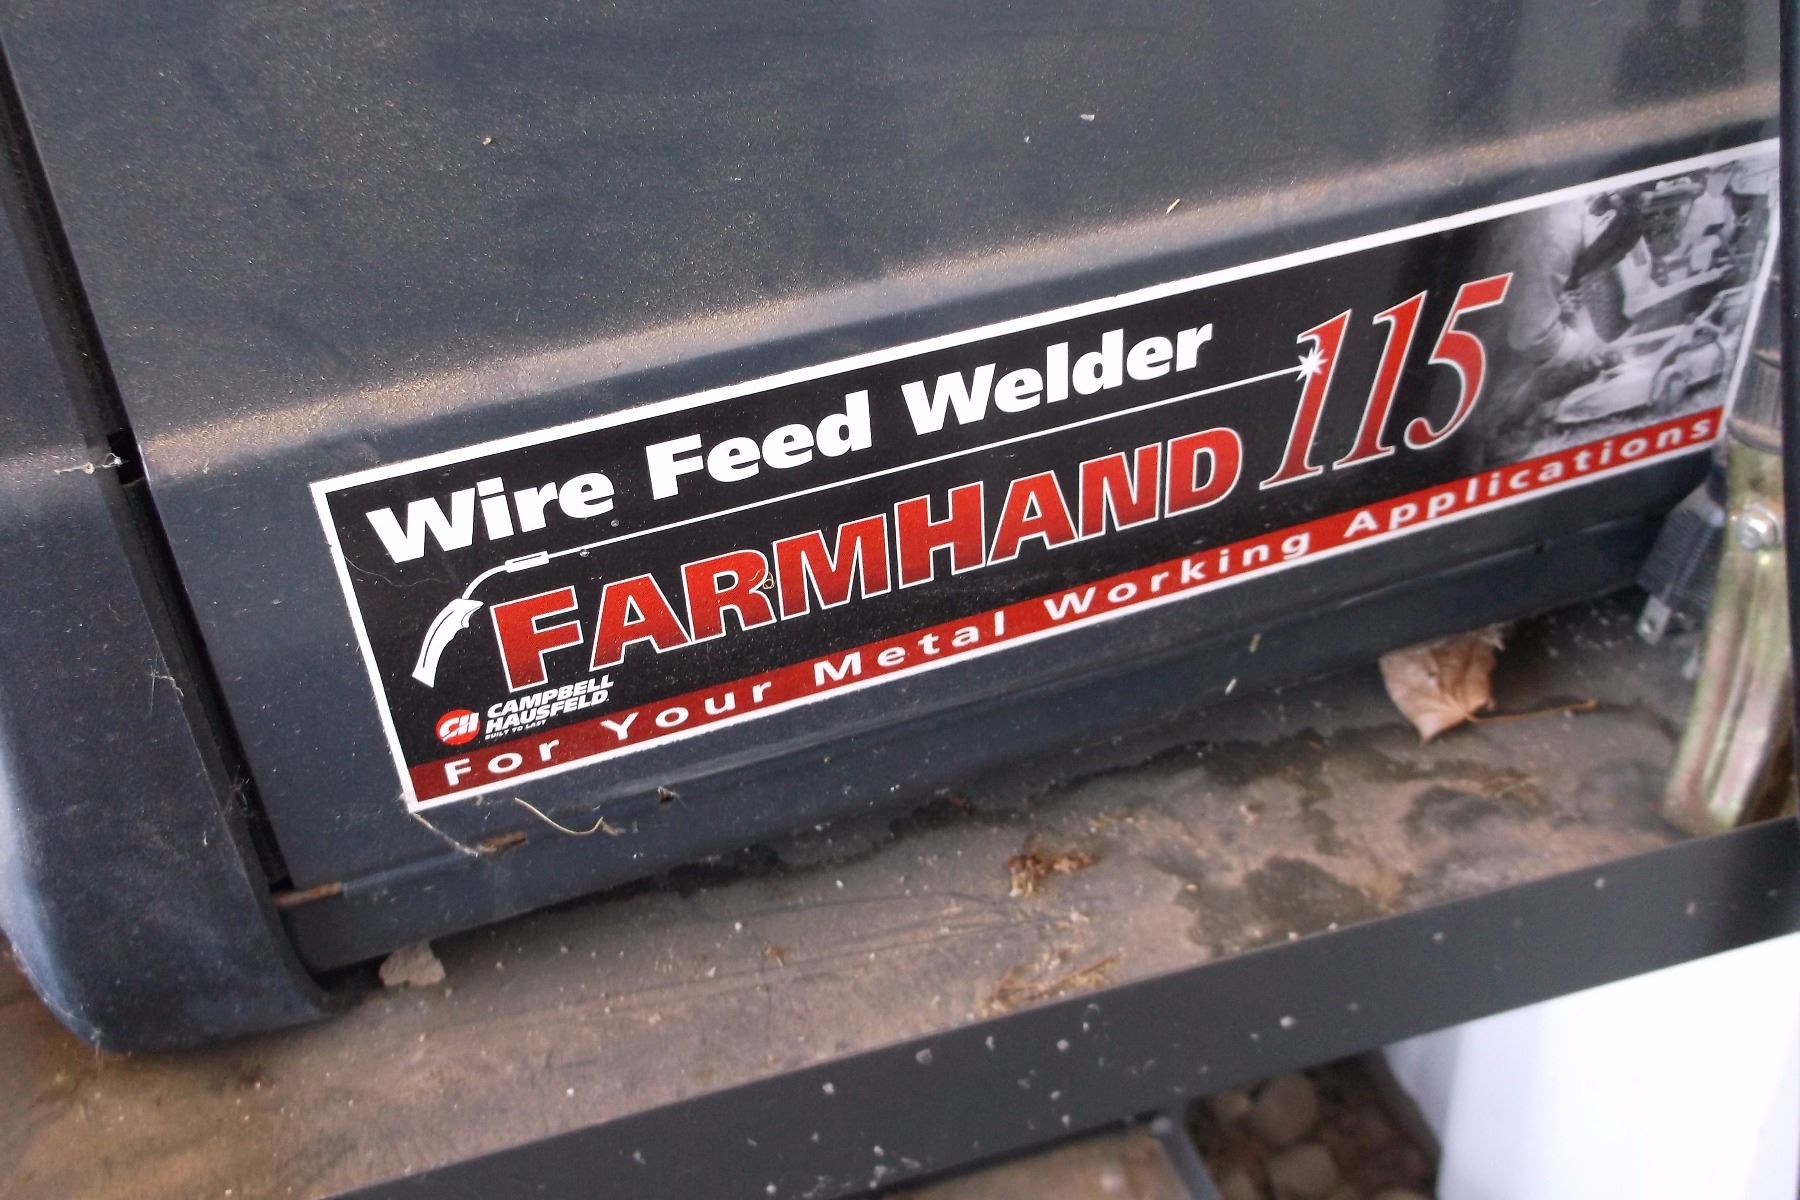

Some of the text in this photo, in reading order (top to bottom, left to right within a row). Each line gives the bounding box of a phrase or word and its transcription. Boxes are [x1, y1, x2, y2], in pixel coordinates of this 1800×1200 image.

[365, 323, 1213, 564] Wire Feed Welder
[489, 272, 1514, 692] FARMHAND 115
[444, 417, 1713, 787] For Your Metal Working Applications
[484, 719, 548, 741] BUILT TO LAST
[485, 689, 610, 734] HAUSFELD
[486, 674, 615, 719] CAMPBELL
